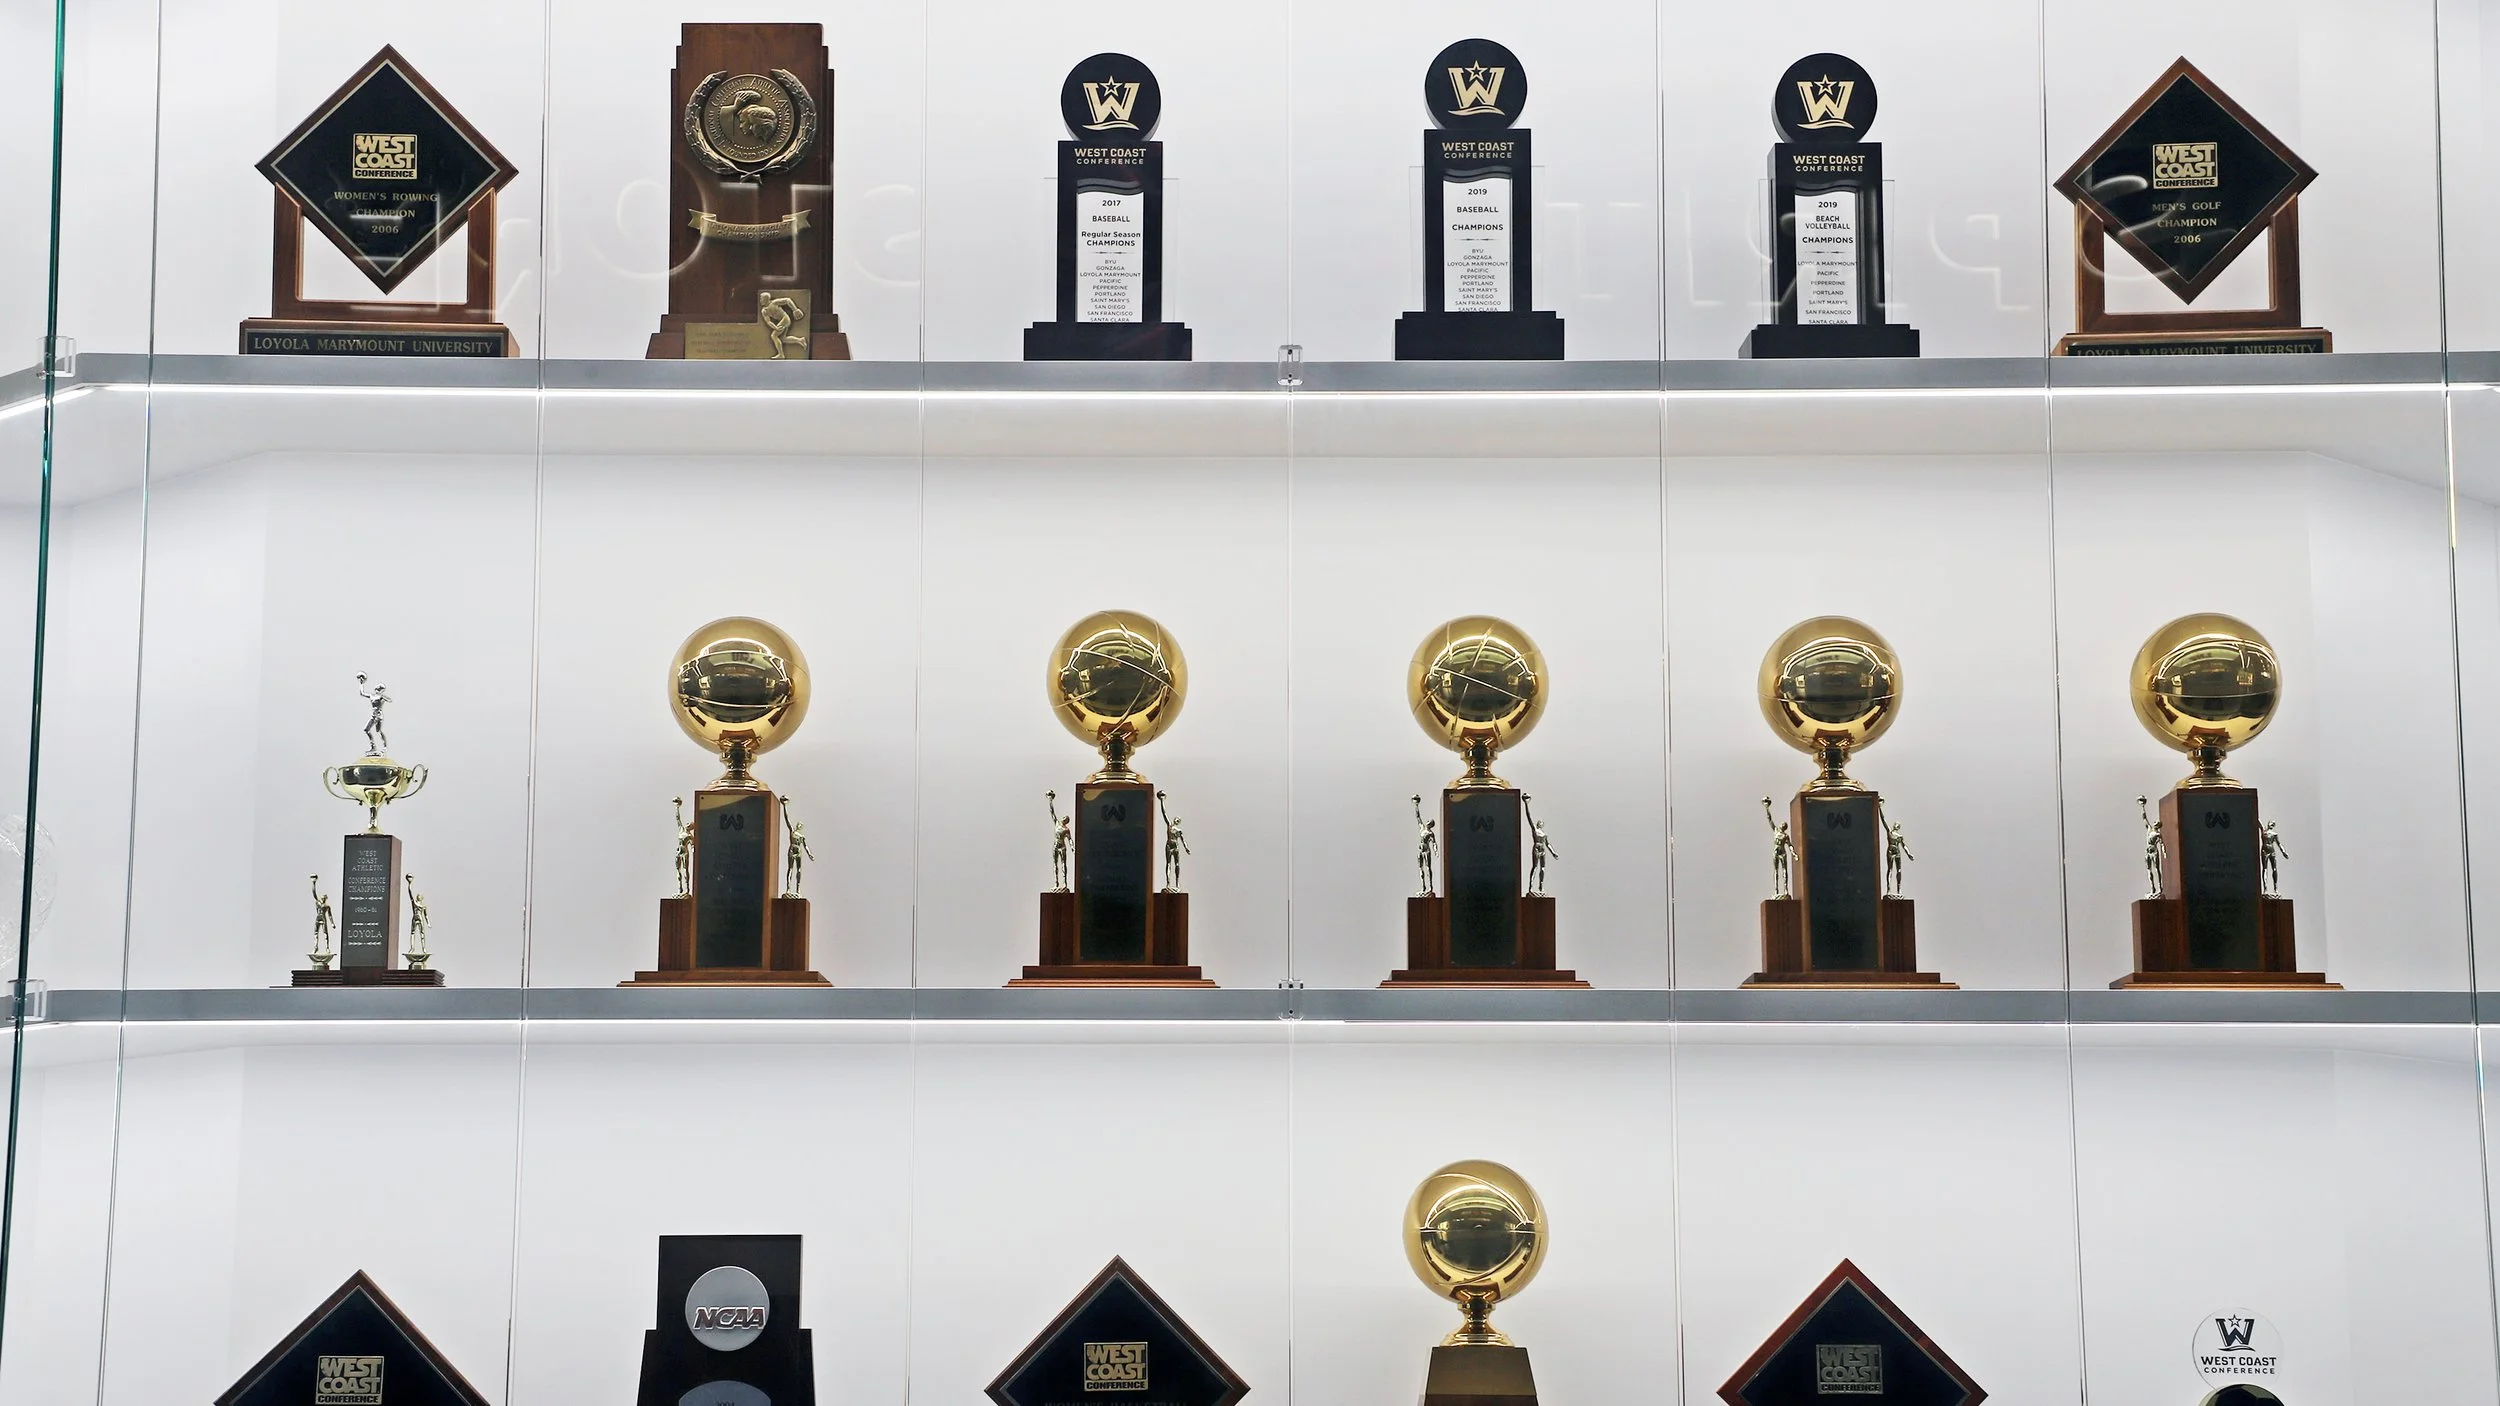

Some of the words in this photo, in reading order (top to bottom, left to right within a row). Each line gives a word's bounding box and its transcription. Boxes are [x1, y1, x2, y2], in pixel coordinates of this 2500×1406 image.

[1447, 67, 1505, 109] W
[1082, 82, 1141, 124] W
[1796, 81, 1855, 123] W
[355, 135, 415, 154] WEST
[1442, 142, 1476, 151] WEST
[1478, 142, 1514, 151] COAST
[1074, 148, 1108, 157] WEST
[1110, 148, 1147, 157] COAST
[2155, 144, 2215, 163] WEST
[355, 153, 415, 169] COAST
[1793, 155, 1827, 165] WEST
[1829, 155, 1865, 165] COAST
[354, 170, 414, 178] CONFERENCE
[2155, 161, 2215, 179] COAST
[2155, 178, 2215, 187] CONFERENCE
[334, 191, 387, 200] WOMEN'S
[392, 193, 438, 202] ROWING
[2152, 203, 2187, 212] MEN'S
[2192, 201, 2222, 210] GOLF
[355, 208, 416, 218] CHAMPION
[1092, 215, 1130, 223] BASEBALL
[2157, 218, 2217, 228] CHAMPION
[371, 225, 399, 234] 2006
[2174, 234, 2201, 244] 2006
[254, 337, 310, 350] LOYOLA
[317, 339, 406, 352] MARYMOUNT
[412, 340, 493, 354] UNIVERSITY
[2234, 344, 2316, 354] UNIVERSITY
[348, 876, 386, 884] CONFERENCE
[347, 930, 383, 938] LOYOLA
[693, 1306, 766, 1330] NCAA
[2215, 1318, 2255, 1347] W
[1087, 1344, 1145, 1364] WEST
[1820, 1347, 1878, 1367] WEST
[2200, 1356, 2236, 1366] WEST
[2239, 1356, 2277, 1366] COAST
[320, 1358, 382, 1377] WEST
[1087, 1364, 1146, 1381] COAST
[1820, 1366, 1879, 1382] COAST
[319, 1377, 381, 1394] COAST
[1086, 1381, 1145, 1390] CONFERENCE
[1821, 1383, 1881, 1392] CONFERENCE
[317, 1394, 379, 1404] CONFERENCE
